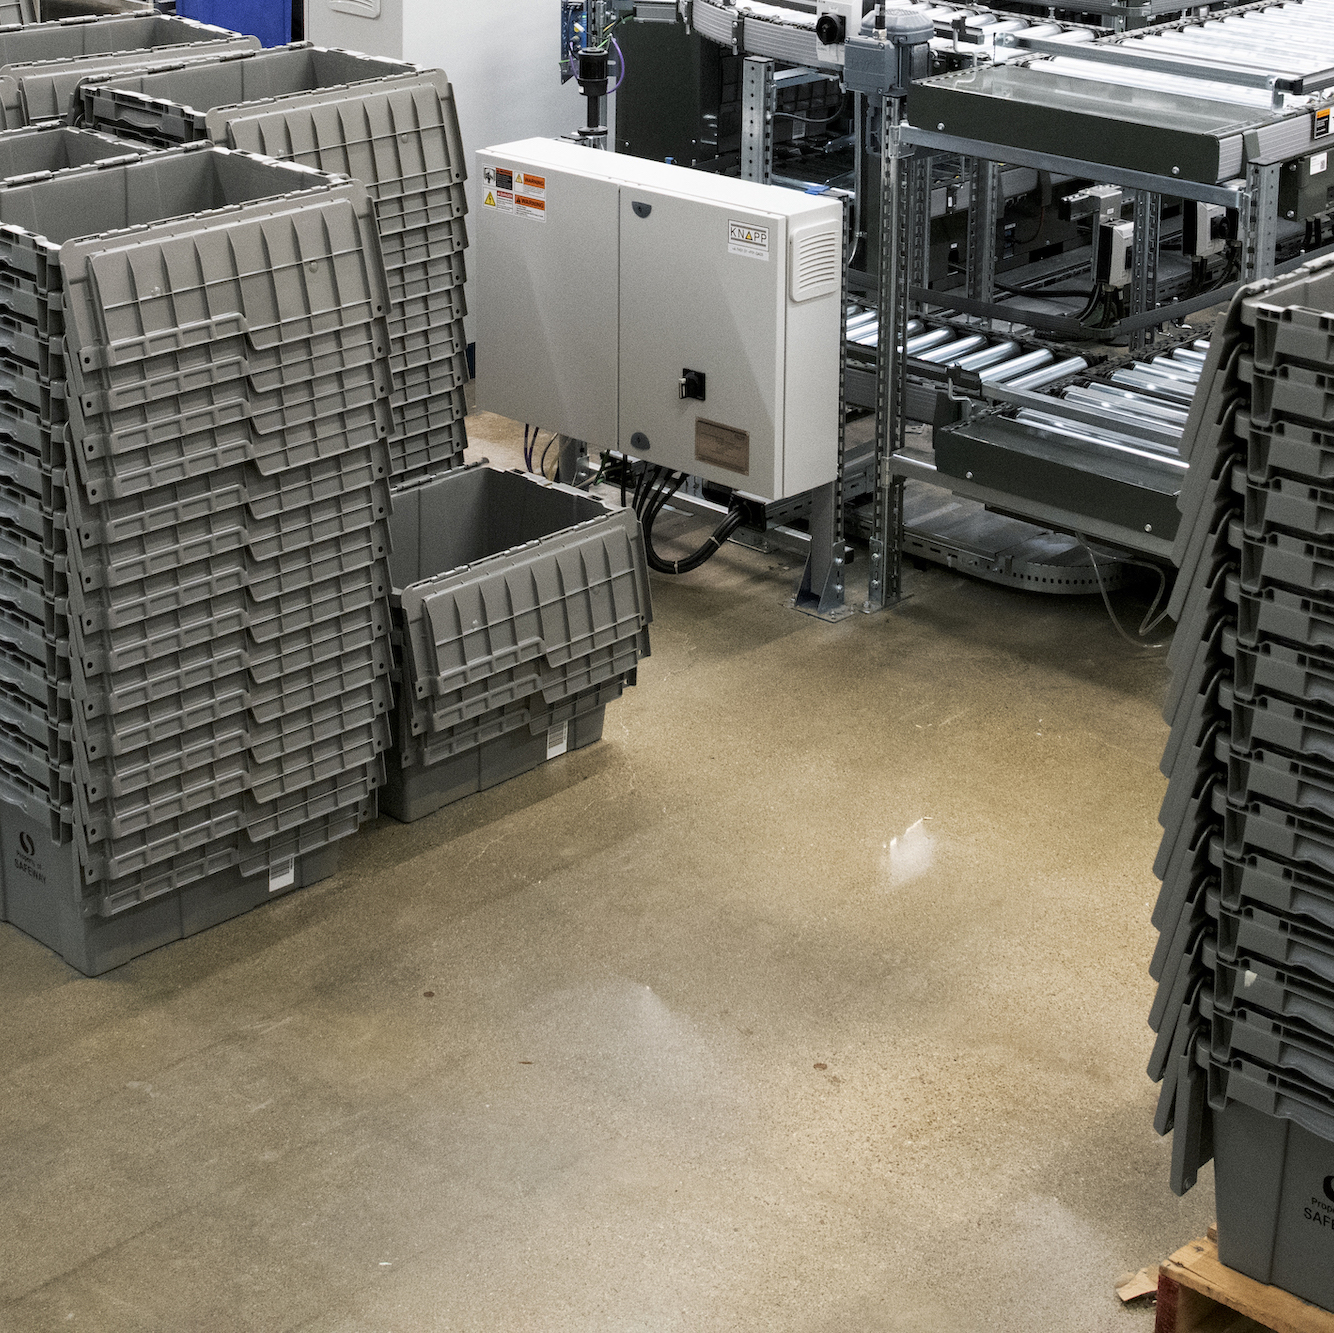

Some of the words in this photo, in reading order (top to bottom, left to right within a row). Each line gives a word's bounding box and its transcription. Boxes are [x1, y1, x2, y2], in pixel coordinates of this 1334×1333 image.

[521, 198, 544, 209] WARNING
[730, 227, 767, 243] KNAPP
[14, 858, 46, 884] SAFEWAY
